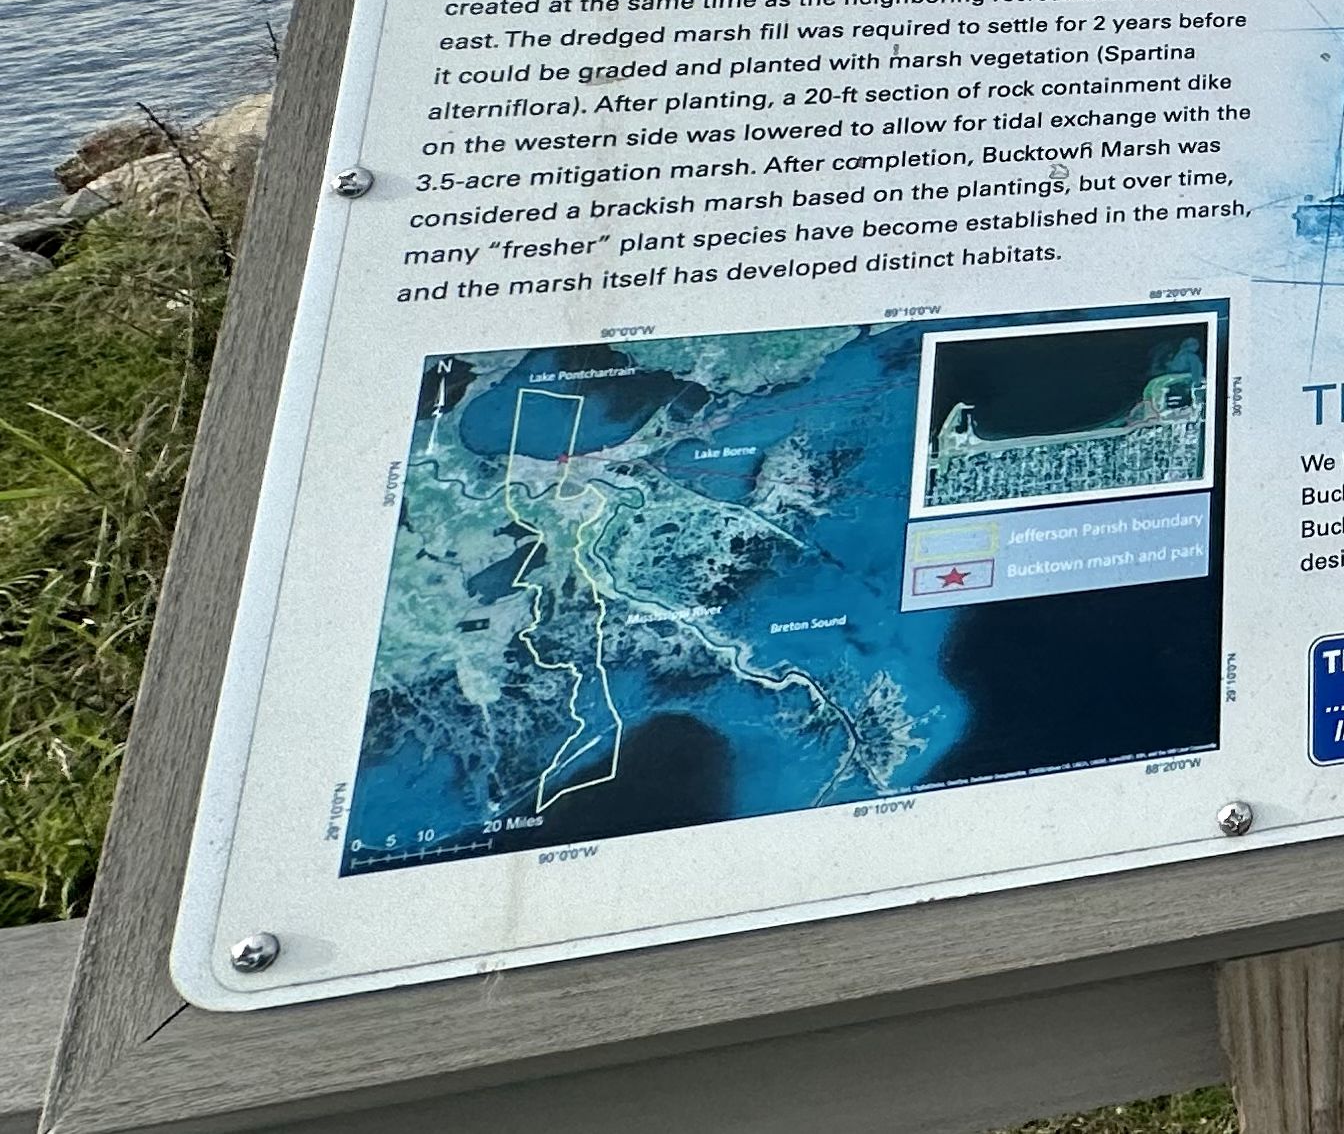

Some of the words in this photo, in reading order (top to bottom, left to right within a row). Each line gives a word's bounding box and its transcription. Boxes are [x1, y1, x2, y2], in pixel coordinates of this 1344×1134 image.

[433, 67, 452, 85] it
[458, 63, 532, 85] could
[538, 63, 571, 81] be
[577, 59, 668, 86] graded
[675, 57, 722, 77] and
[729, 54, 822, 79] planted
[828, 52, 880, 71] with
[890, 49, 963, 70] marsh
[969, 46, 1089, 70] vegetation
[1097, 43, 1196, 66] (Spartina
[427, 95, 587, 121] alterniflora).
[593, 94, 659, 114] After
[664, 90, 775, 115] planting,
[782, 92, 796, 106] a
[803, 85, 859, 105] 20-ft
[864, 83, 949, 103] section
[957, 81, 982, 100] of
[987, 79, 1035, 99] rock
[1041, 76, 1181, 96] containment
[1187, 73, 1232, 91] dike
[415, 172, 522, 192] 3.5-acre
[529, 163, 661, 188] mitigation
[670, 157, 757, 179] marsh.
[762, 155, 826, 175] After
[831, 148, 975, 173] completion,
[982, 141, 1093, 164] Bucktown
[1101, 138, 1171, 158] Marsh
[1177, 140, 1221, 155] was
[403, 247, 481, 266] many
[619, 232, 686, 257] plant
[692, 225, 787, 252] species
[795, 223, 855, 242] have
[862, 219, 958, 238] become
[965, 206, 1098, 232] established
[1105, 205, 1126, 224] in
[1132, 203, 1169, 222] the
[1176, 199, 1253, 220] marsh,
[396, 280, 449, 303] and
[457, 279, 500, 299] the
[508, 271, 593, 296] marsh
[602, 266, 668, 290] itself
[673, 266, 718, 285] has
[726, 254, 858, 281] developed
[865, 250, 955, 272] distinct
[962, 244, 1062, 266] habitats.
[437, 359, 453, 374] N
[529, 371, 556, 383] Lake
[558, 367, 636, 381] Pontchartrain
[694, 447, 720, 460] Lake
[723, 445, 757, 457] Borne
[1300, 453, 1336, 474] We
[1007, 527, 1078, 545] Jefferson
[1083, 519, 1127, 535] Parish
[1132, 513, 1203, 531] boundary
[1007, 557, 1084, 578] Bucktown
[1088, 552, 1135, 569] marsh
[1138, 546, 1166, 562] and
[1171, 543, 1203, 561] park
[770, 620, 809, 634] Breton
[810, 615, 847, 629] Sound
[351, 839, 362, 853] 0
[385, 834, 397, 848] 5
[417, 829, 435, 843] 10
[482, 820, 502, 835] 20
[505, 815, 544, 831] Miles
